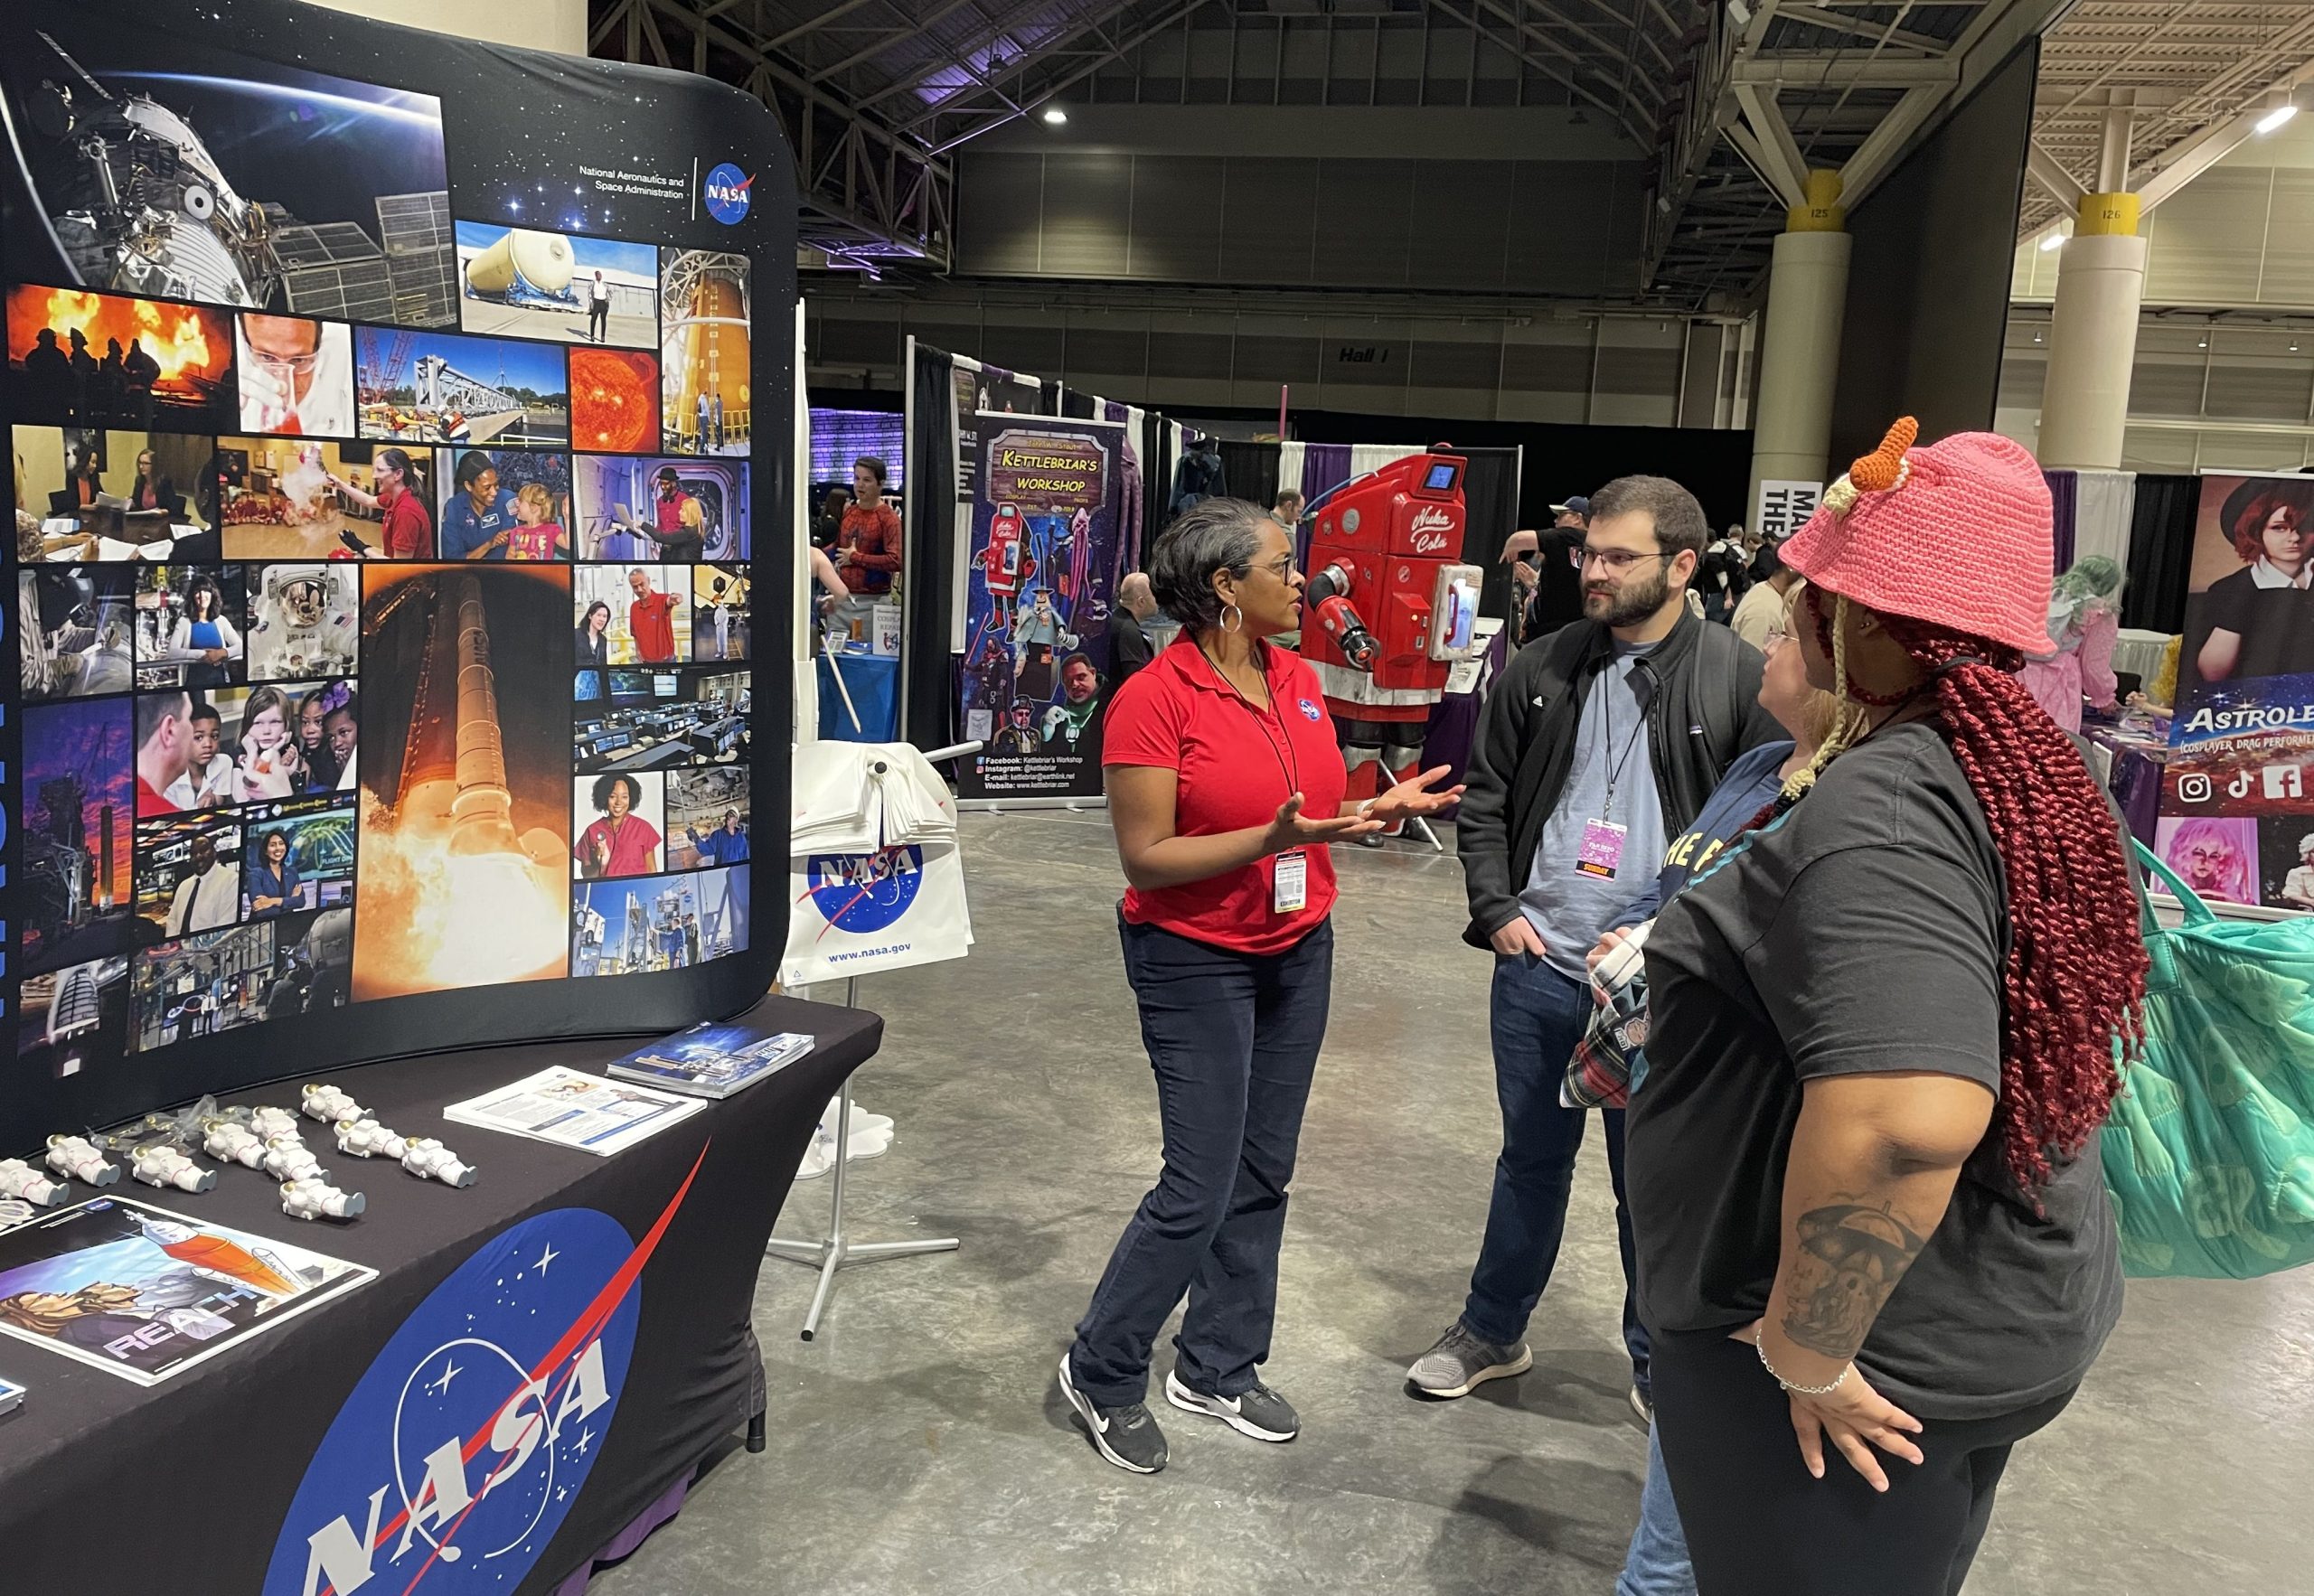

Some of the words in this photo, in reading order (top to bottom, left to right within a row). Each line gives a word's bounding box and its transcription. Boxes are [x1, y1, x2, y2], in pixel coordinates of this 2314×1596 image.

[579, 165, 616, 179] National
[616, 171, 667, 185] Aeronautics
[669, 178, 684, 187] and
[595, 181, 624, 192] Space
[625, 184, 683, 199] Administration
[708, 184, 748, 203] NASA
[1811, 209, 1830, 218] 125
[2102, 210, 2121, 220] 126
[1340, 347, 1376, 361] Hall
[1002, 450, 1097, 471] KETTLEBRIAR'S
[1017, 477, 1086, 493] WORKSHOP
[1412, 505, 1453, 531] Nuka
[1411, 531, 1447, 553] Cola
[2236, 738, 2262, 751] DRAG
[985, 765, 1023, 774] Instagram:
[819, 849, 918, 888] NASA
[829, 943, 912, 962] www.nasa.gov
[102, 1285, 259, 1360] REACH
[303, 1338, 612, 1596] NASA
